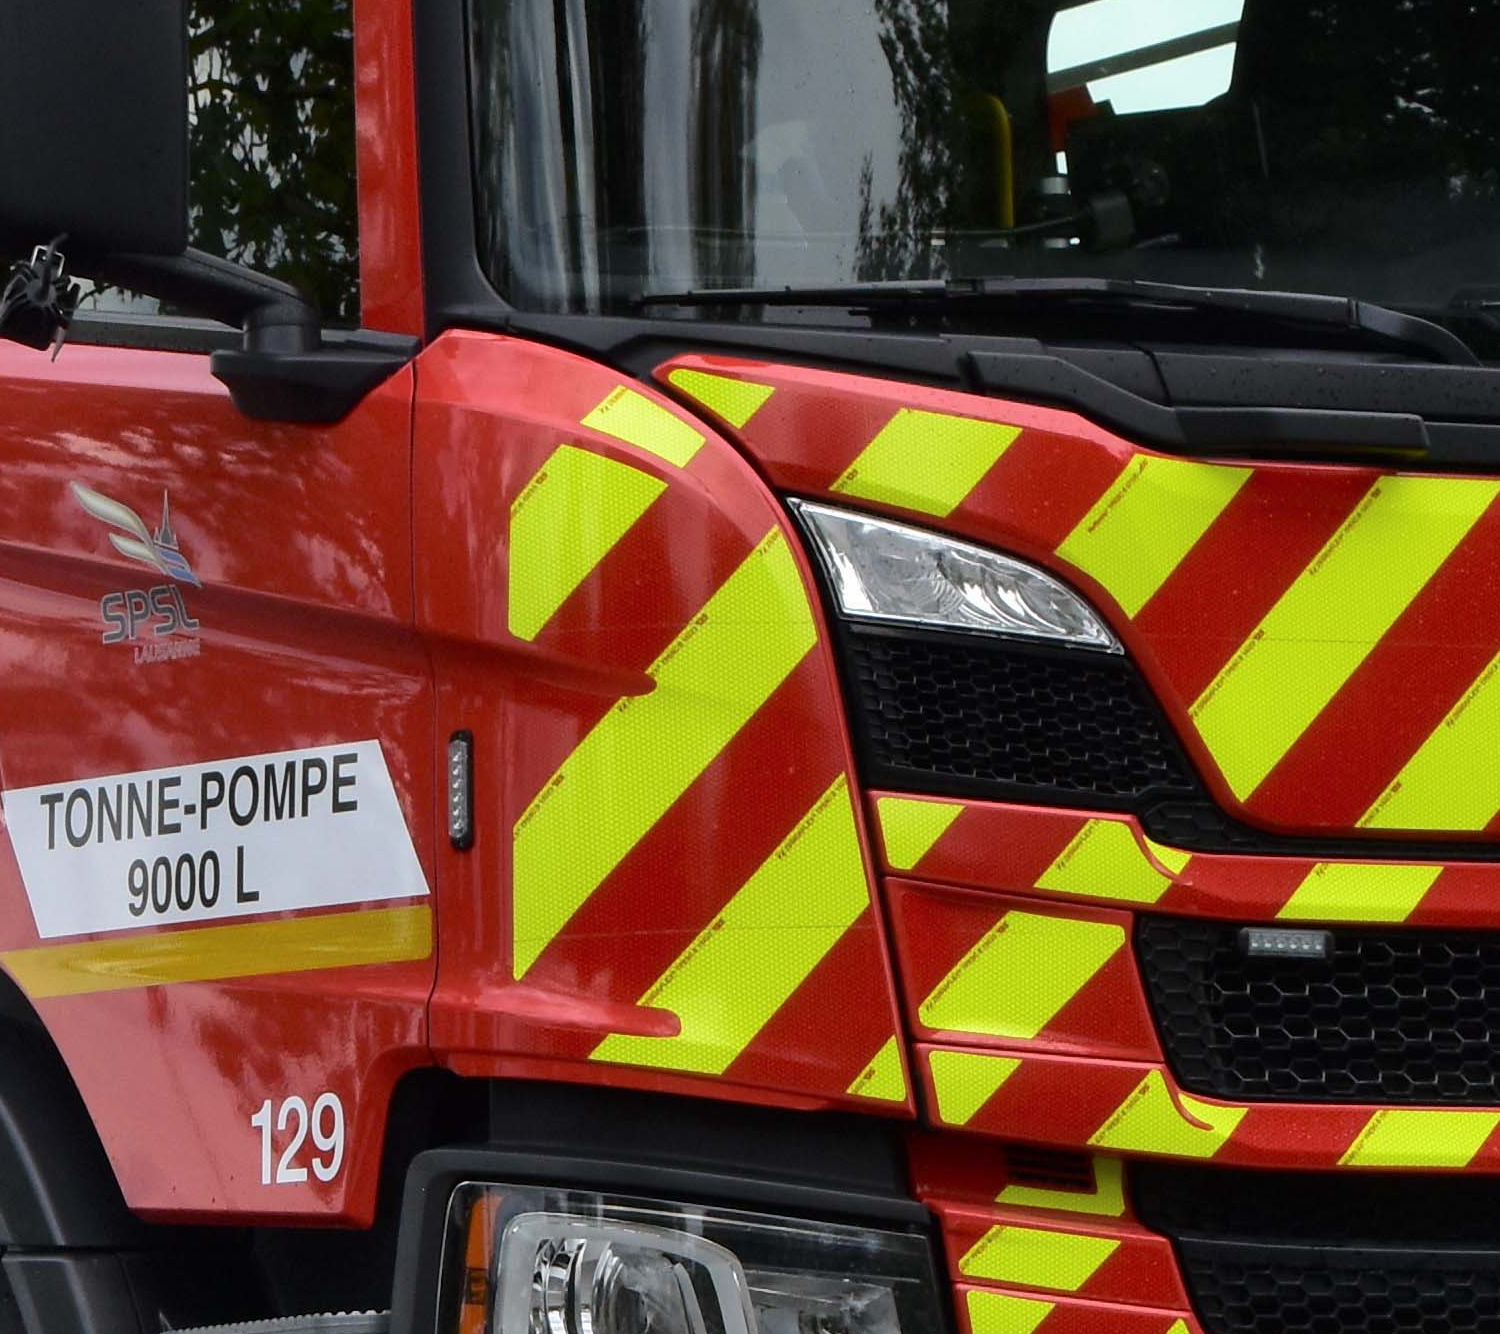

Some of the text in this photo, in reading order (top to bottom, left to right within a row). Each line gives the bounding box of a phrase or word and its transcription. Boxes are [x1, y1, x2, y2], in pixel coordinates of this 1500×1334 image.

[100, 584, 200, 645] SPSL
[39, 752, 360, 851] TONNE-POMPE
[127, 845, 261, 918] 9000 L
[250, 1093, 346, 1186] 129
